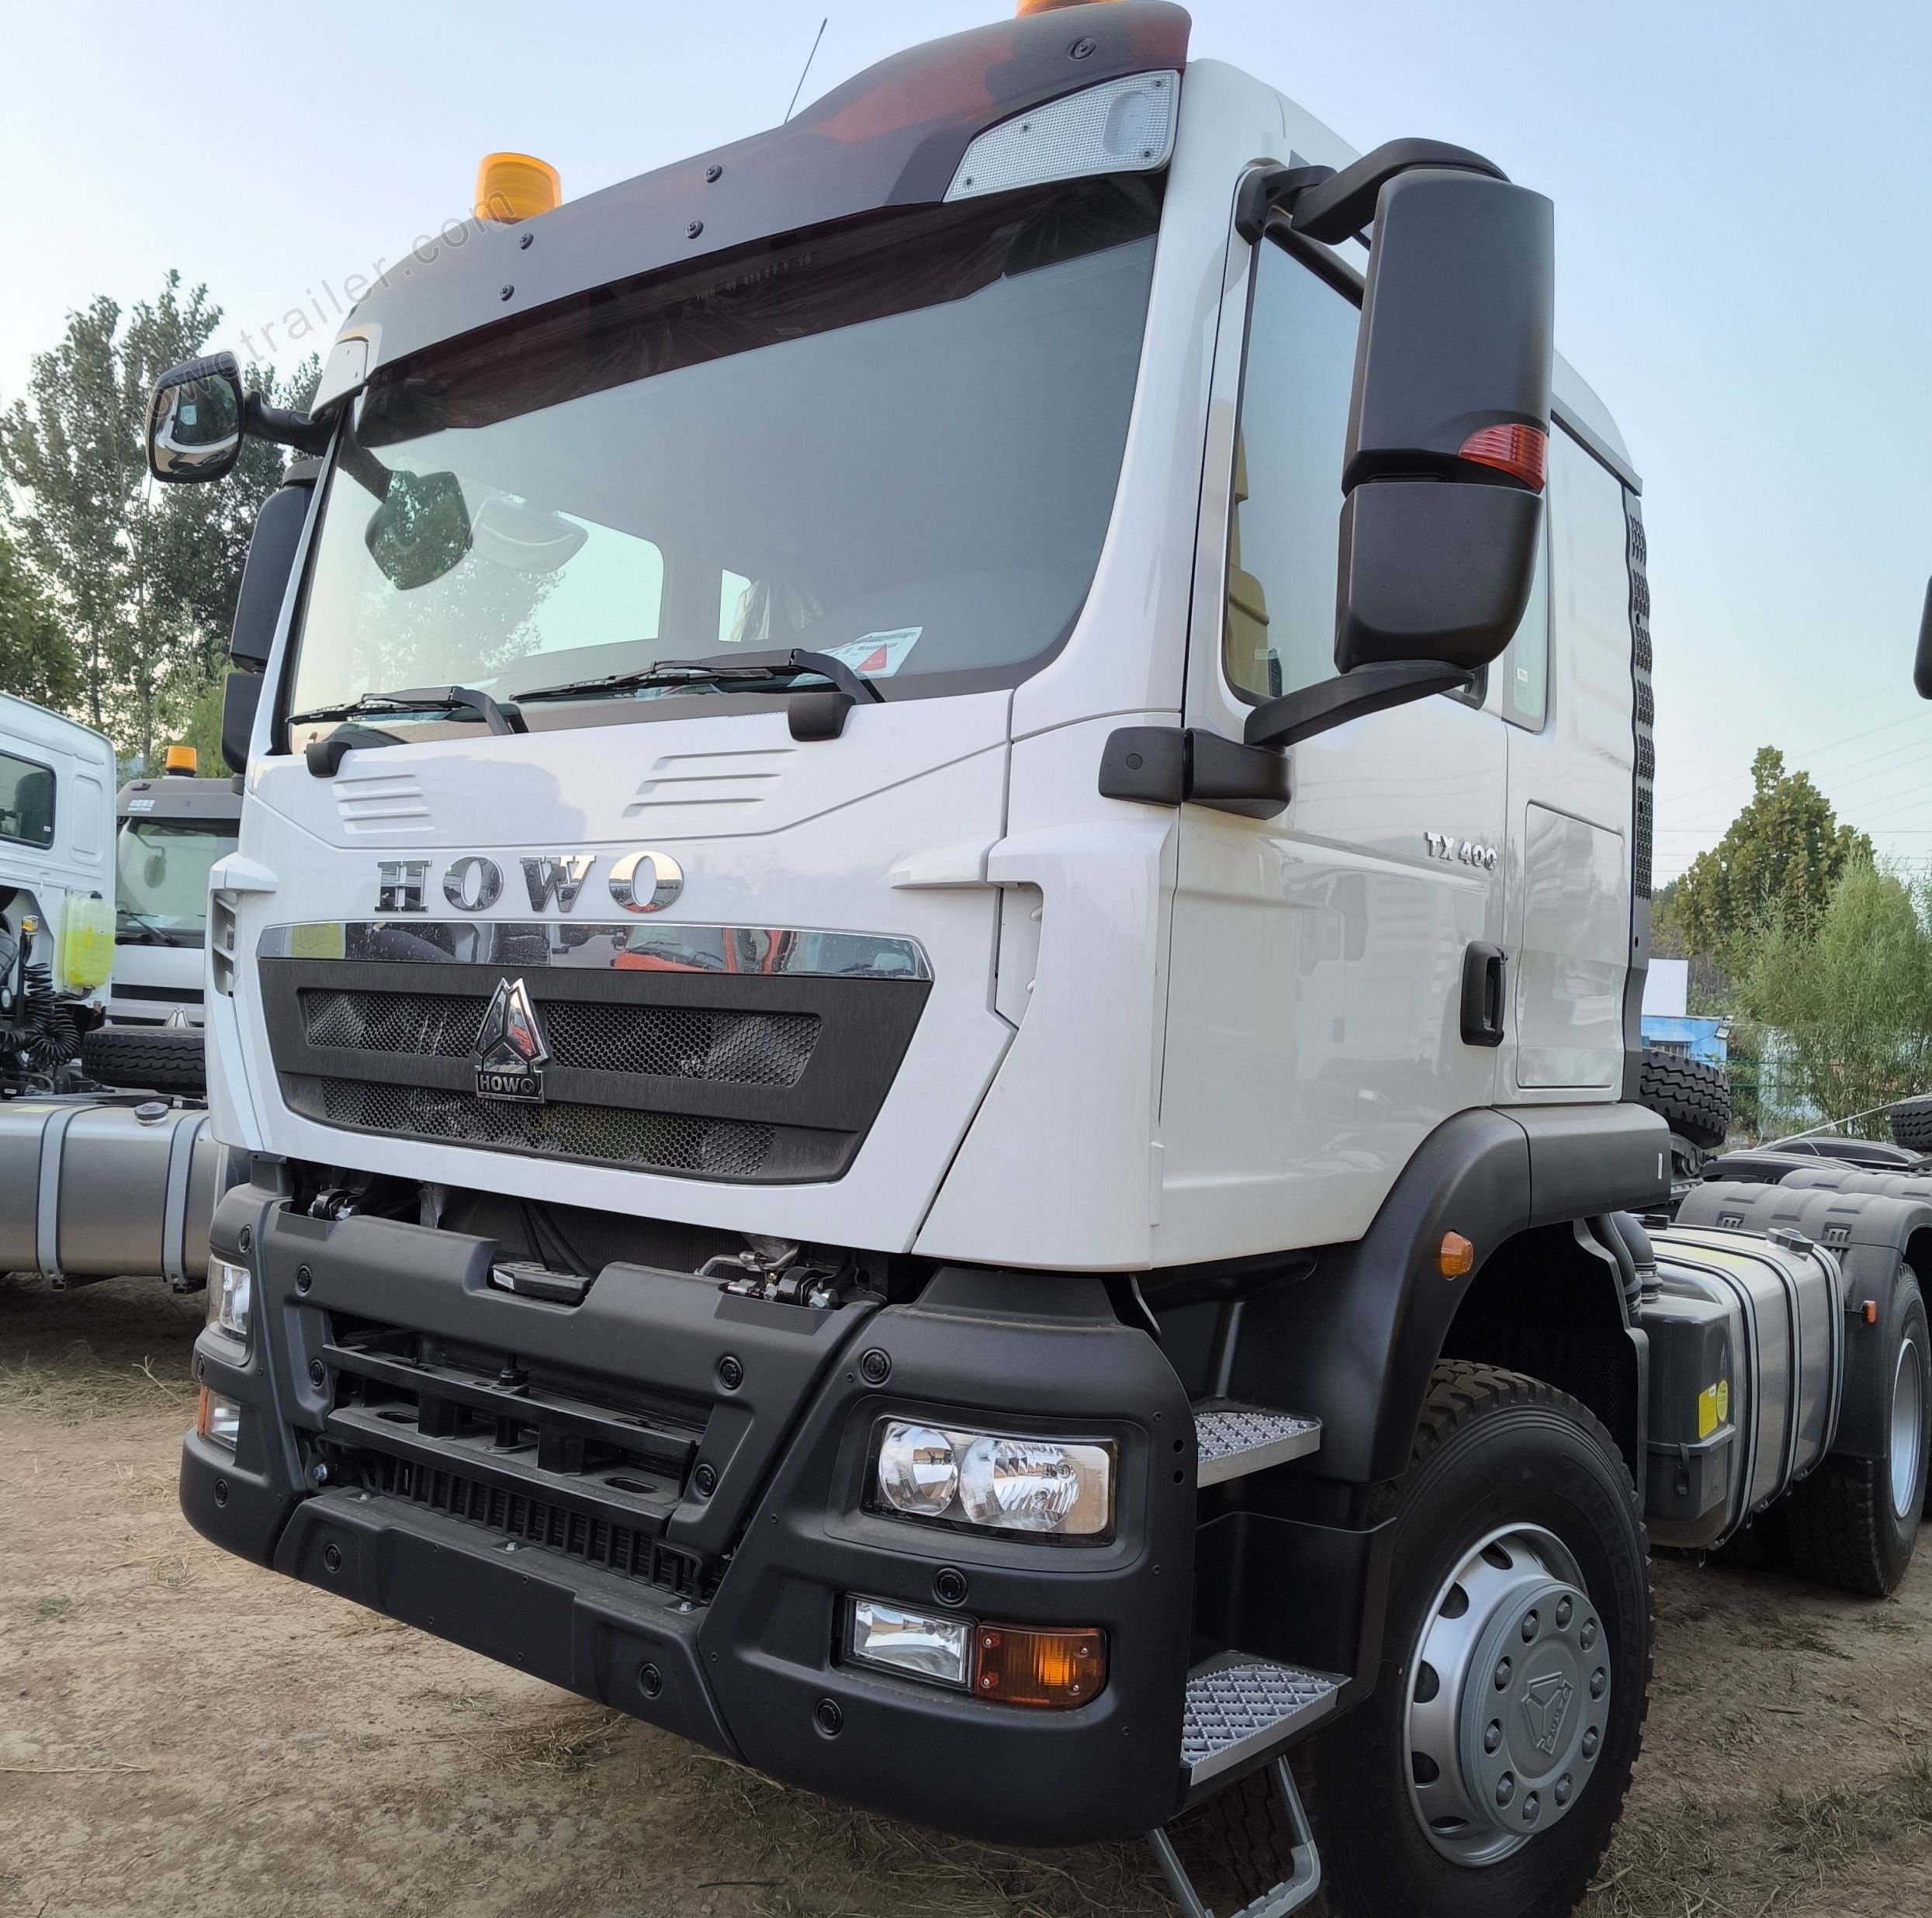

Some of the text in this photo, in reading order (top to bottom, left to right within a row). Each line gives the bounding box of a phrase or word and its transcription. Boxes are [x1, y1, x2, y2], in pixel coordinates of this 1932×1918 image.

[1424, 831, 1497, 871] TX 400
[373, 850, 685, 913] HOWO
[479, 1074, 535, 1094] HOWO
